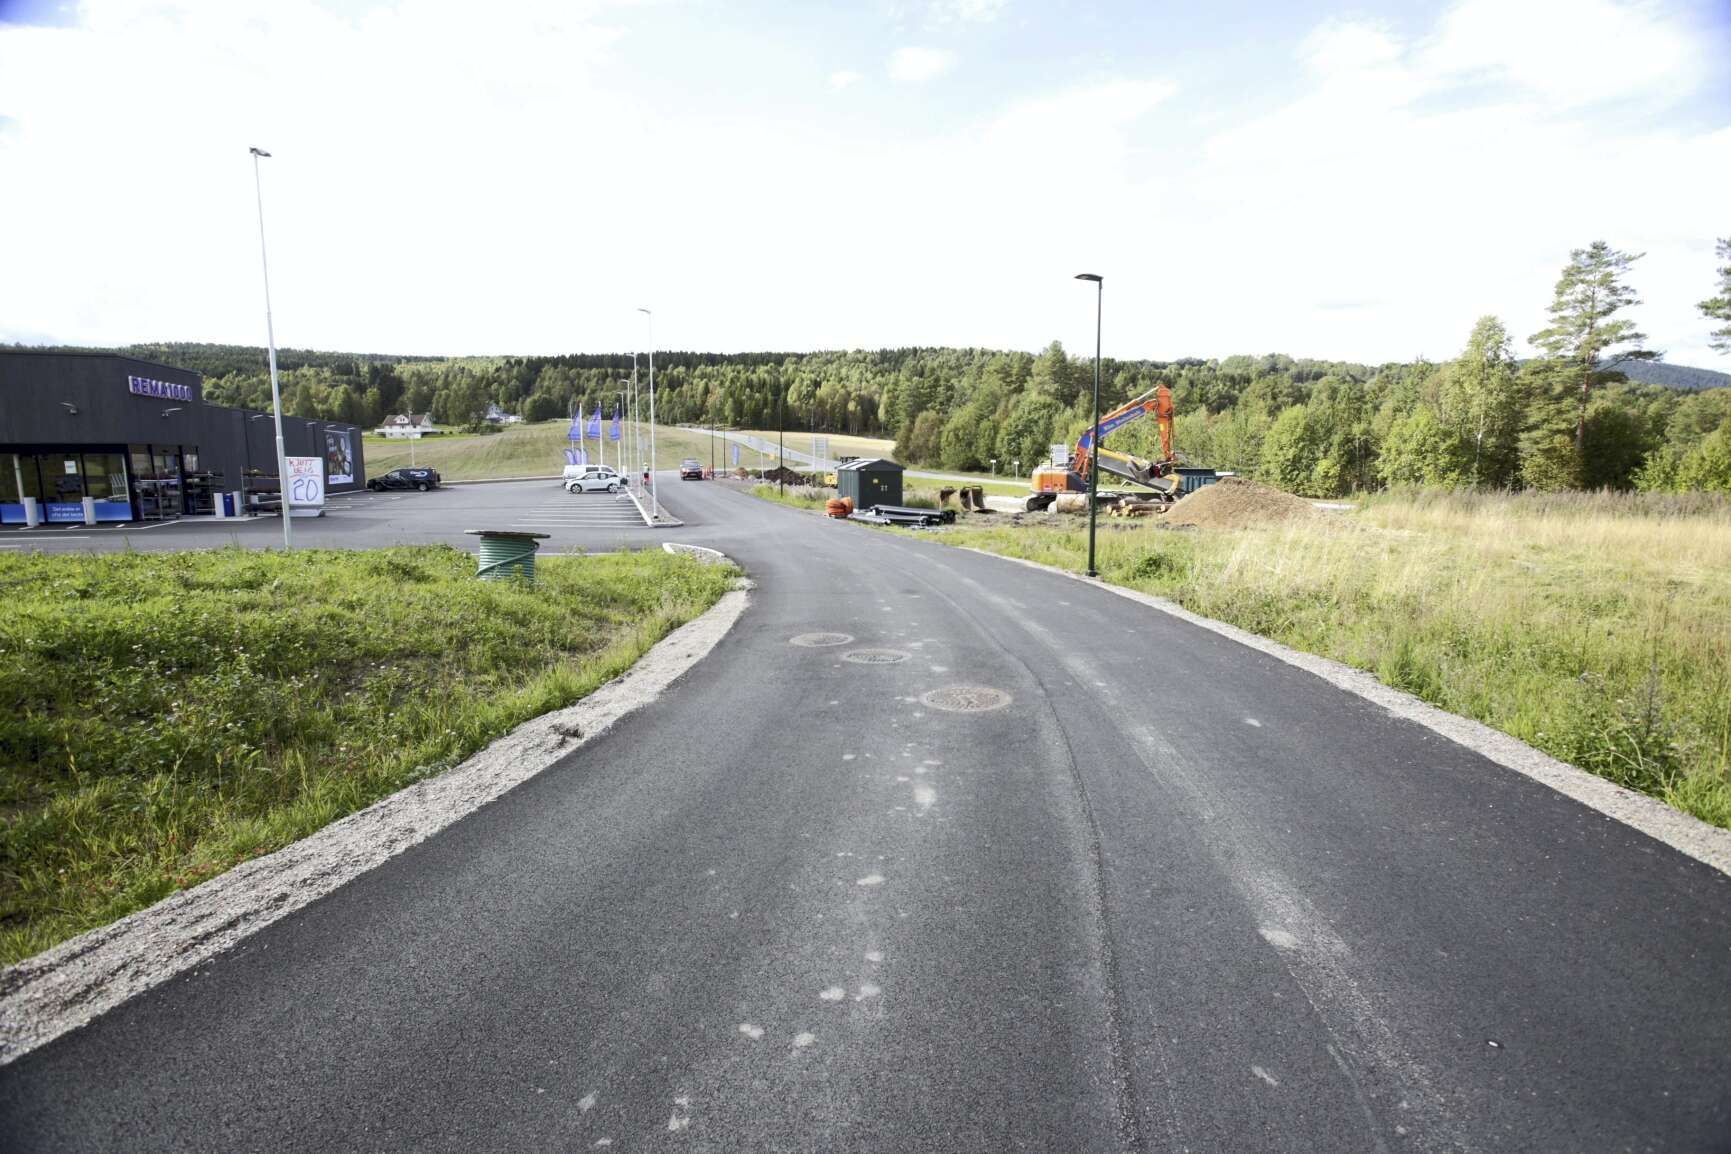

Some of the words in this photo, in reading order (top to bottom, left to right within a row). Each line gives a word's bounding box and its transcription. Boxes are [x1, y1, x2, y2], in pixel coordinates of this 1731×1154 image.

[128, 376, 168, 399] REMA
[166, 382, 192, 401] 1000
[293, 479, 318, 501] 20
